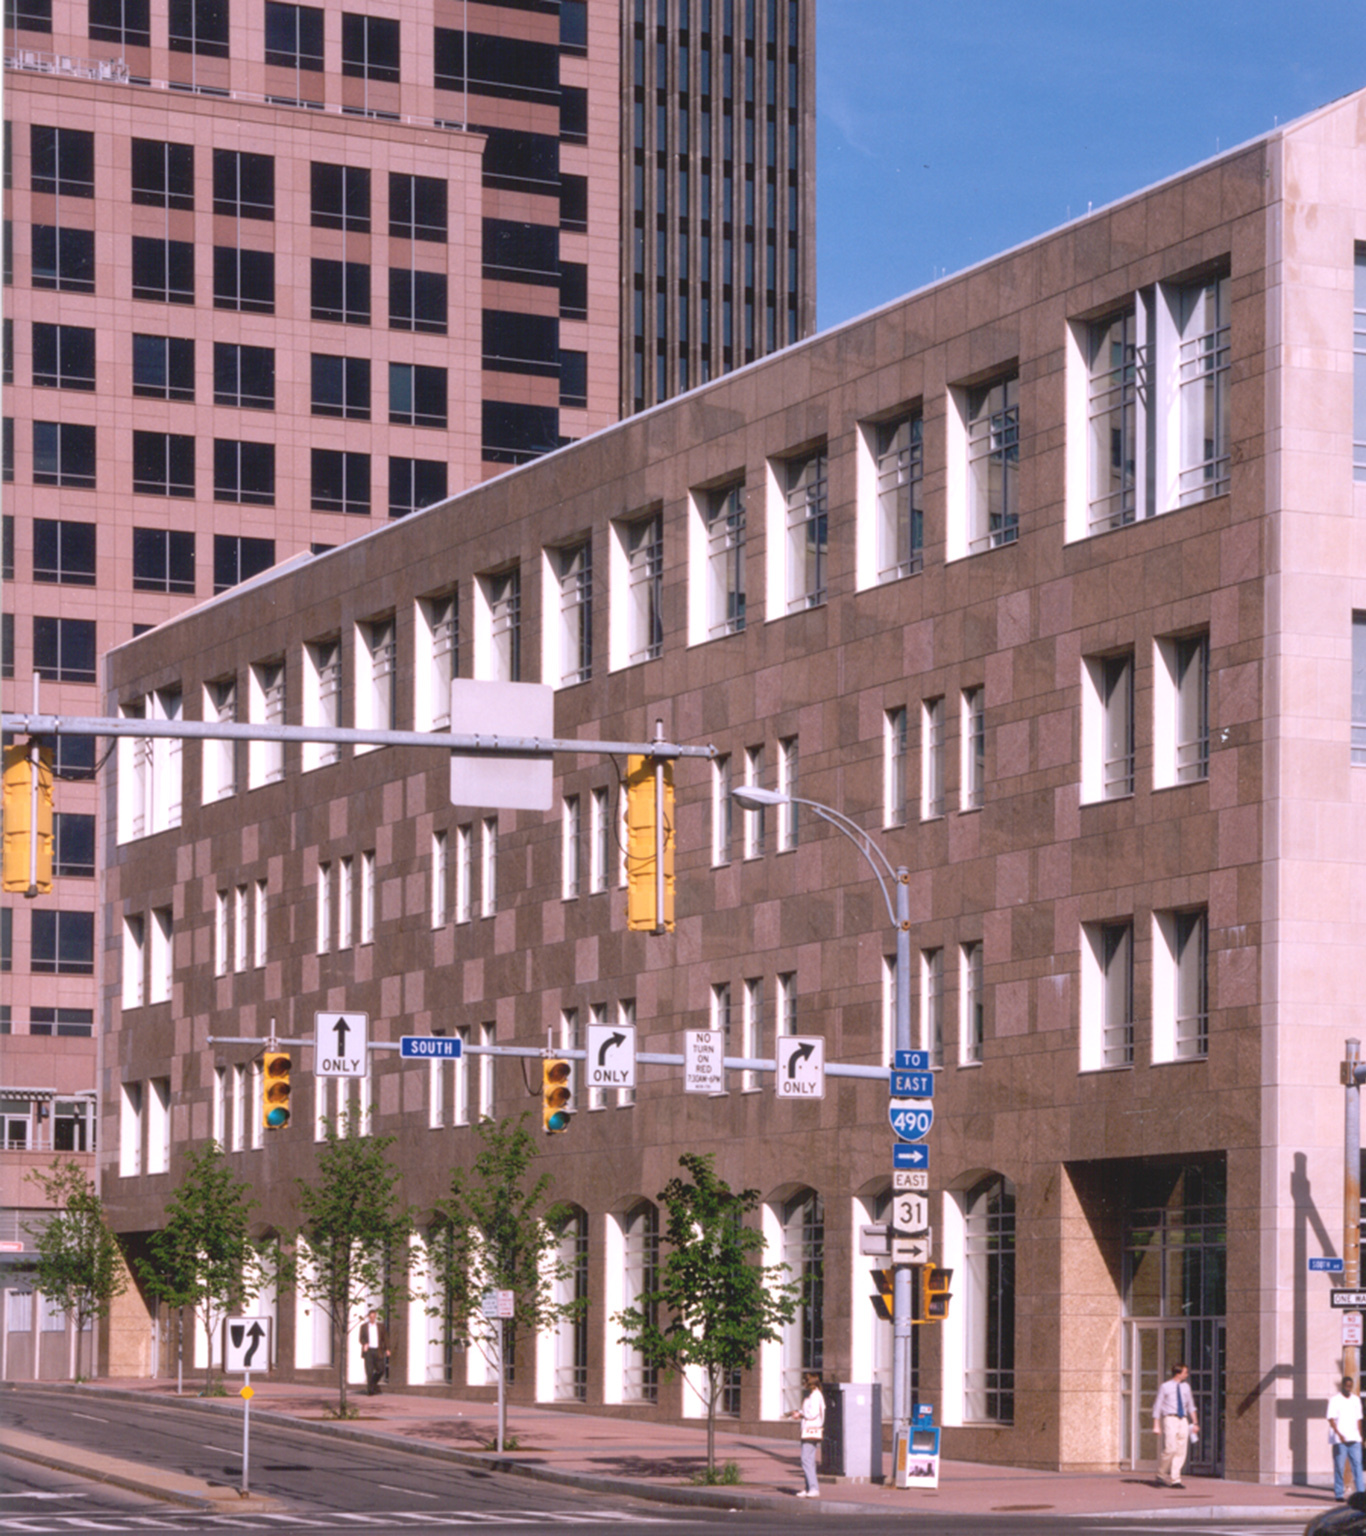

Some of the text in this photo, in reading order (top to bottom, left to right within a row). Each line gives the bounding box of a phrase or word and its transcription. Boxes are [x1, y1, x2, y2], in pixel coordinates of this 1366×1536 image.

[696, 1033, 711, 1043] NO
[411, 1040, 453, 1055] SOUTH
[693, 1044, 714, 1053] TURN
[322, 1058, 360, 1072] ONLY
[697, 1055, 709, 1063] ON
[903, 1054, 921, 1066] TO
[695, 1065, 712, 1073] RED
[593, 1069, 629, 1083] ONLY
[783, 1082, 817, 1094] ONLY
[896, 1077, 928, 1091] EAST
[894, 1112, 929, 1132] 490
[896, 1174, 927, 1186] EAST
[900, 1202, 921, 1224] 31
[1335, 1295, 1352, 1303] ONE
